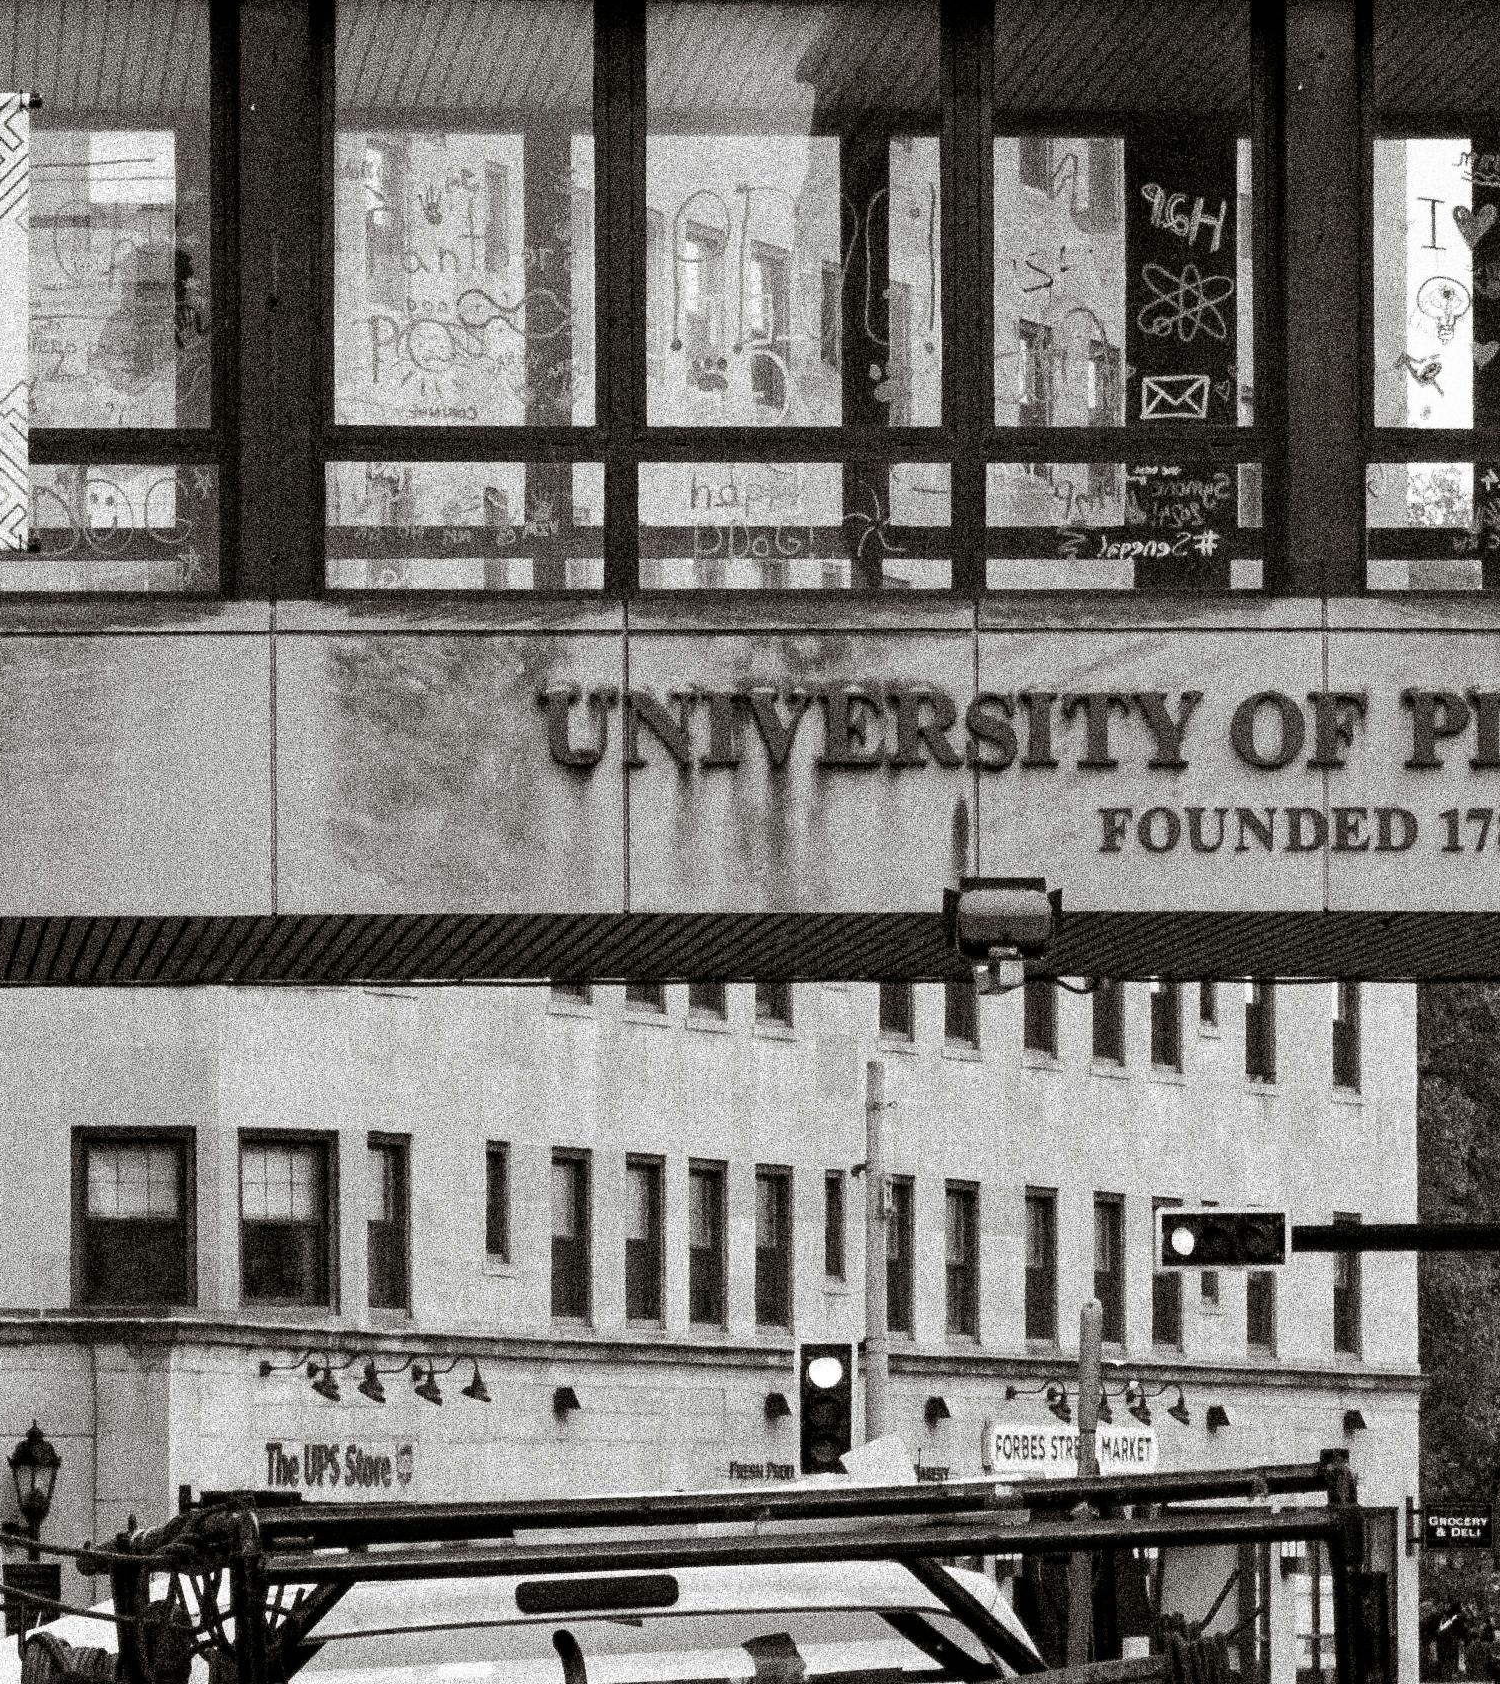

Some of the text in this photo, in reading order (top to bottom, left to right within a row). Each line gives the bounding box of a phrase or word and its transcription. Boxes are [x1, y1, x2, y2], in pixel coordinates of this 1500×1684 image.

[538, 687, 1203, 774] UNIVERSITY
[1229, 690, 1368, 772] OF
[1098, 806, 1417, 854] FOUNDED
[266, 1443, 392, 1488] The UPS Store
[995, 1435, 1152, 1462] FORBES STRE MARKET
[1429, 1515, 1489, 1527] GROCERY
